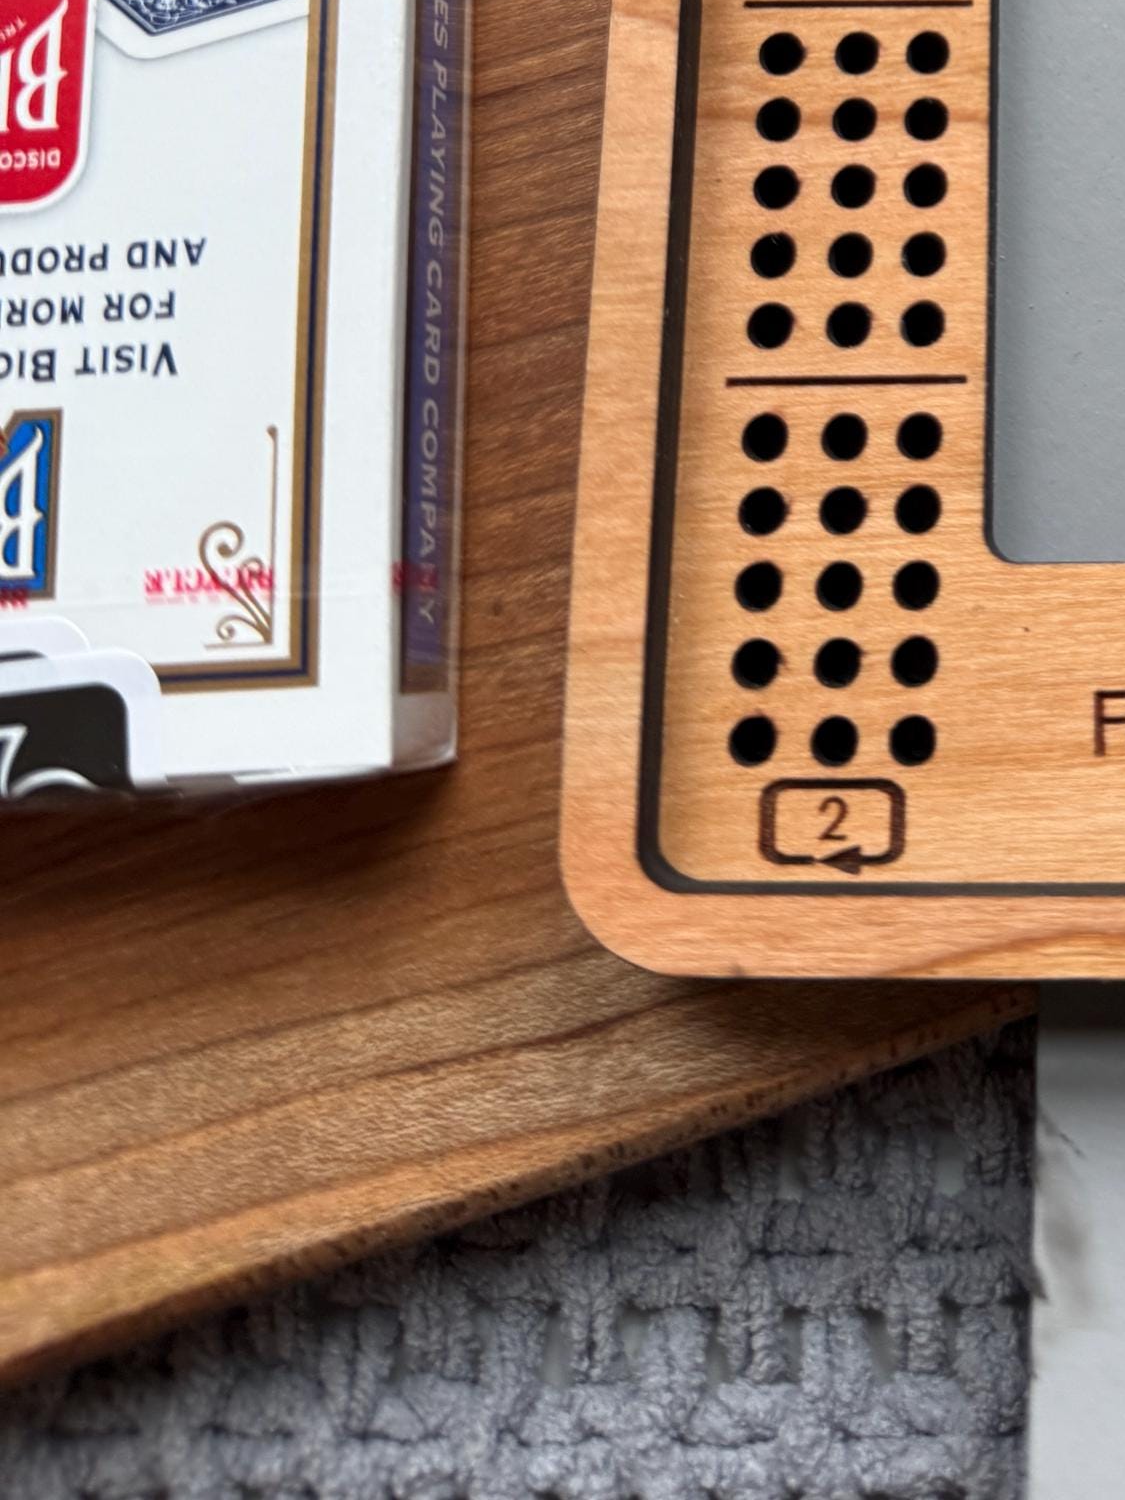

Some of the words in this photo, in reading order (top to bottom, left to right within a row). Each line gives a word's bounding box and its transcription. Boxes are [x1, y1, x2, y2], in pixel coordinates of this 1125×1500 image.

[427, 59, 448, 248] PLAYING
[127, 237, 206, 270] AND
[0, 296, 84, 328] MOR
[103, 290, 175, 322] FOR
[424, 259, 443, 386] CARD
[75, 342, 178, 377] VISIT
[817, 796, 849, 841] 2
